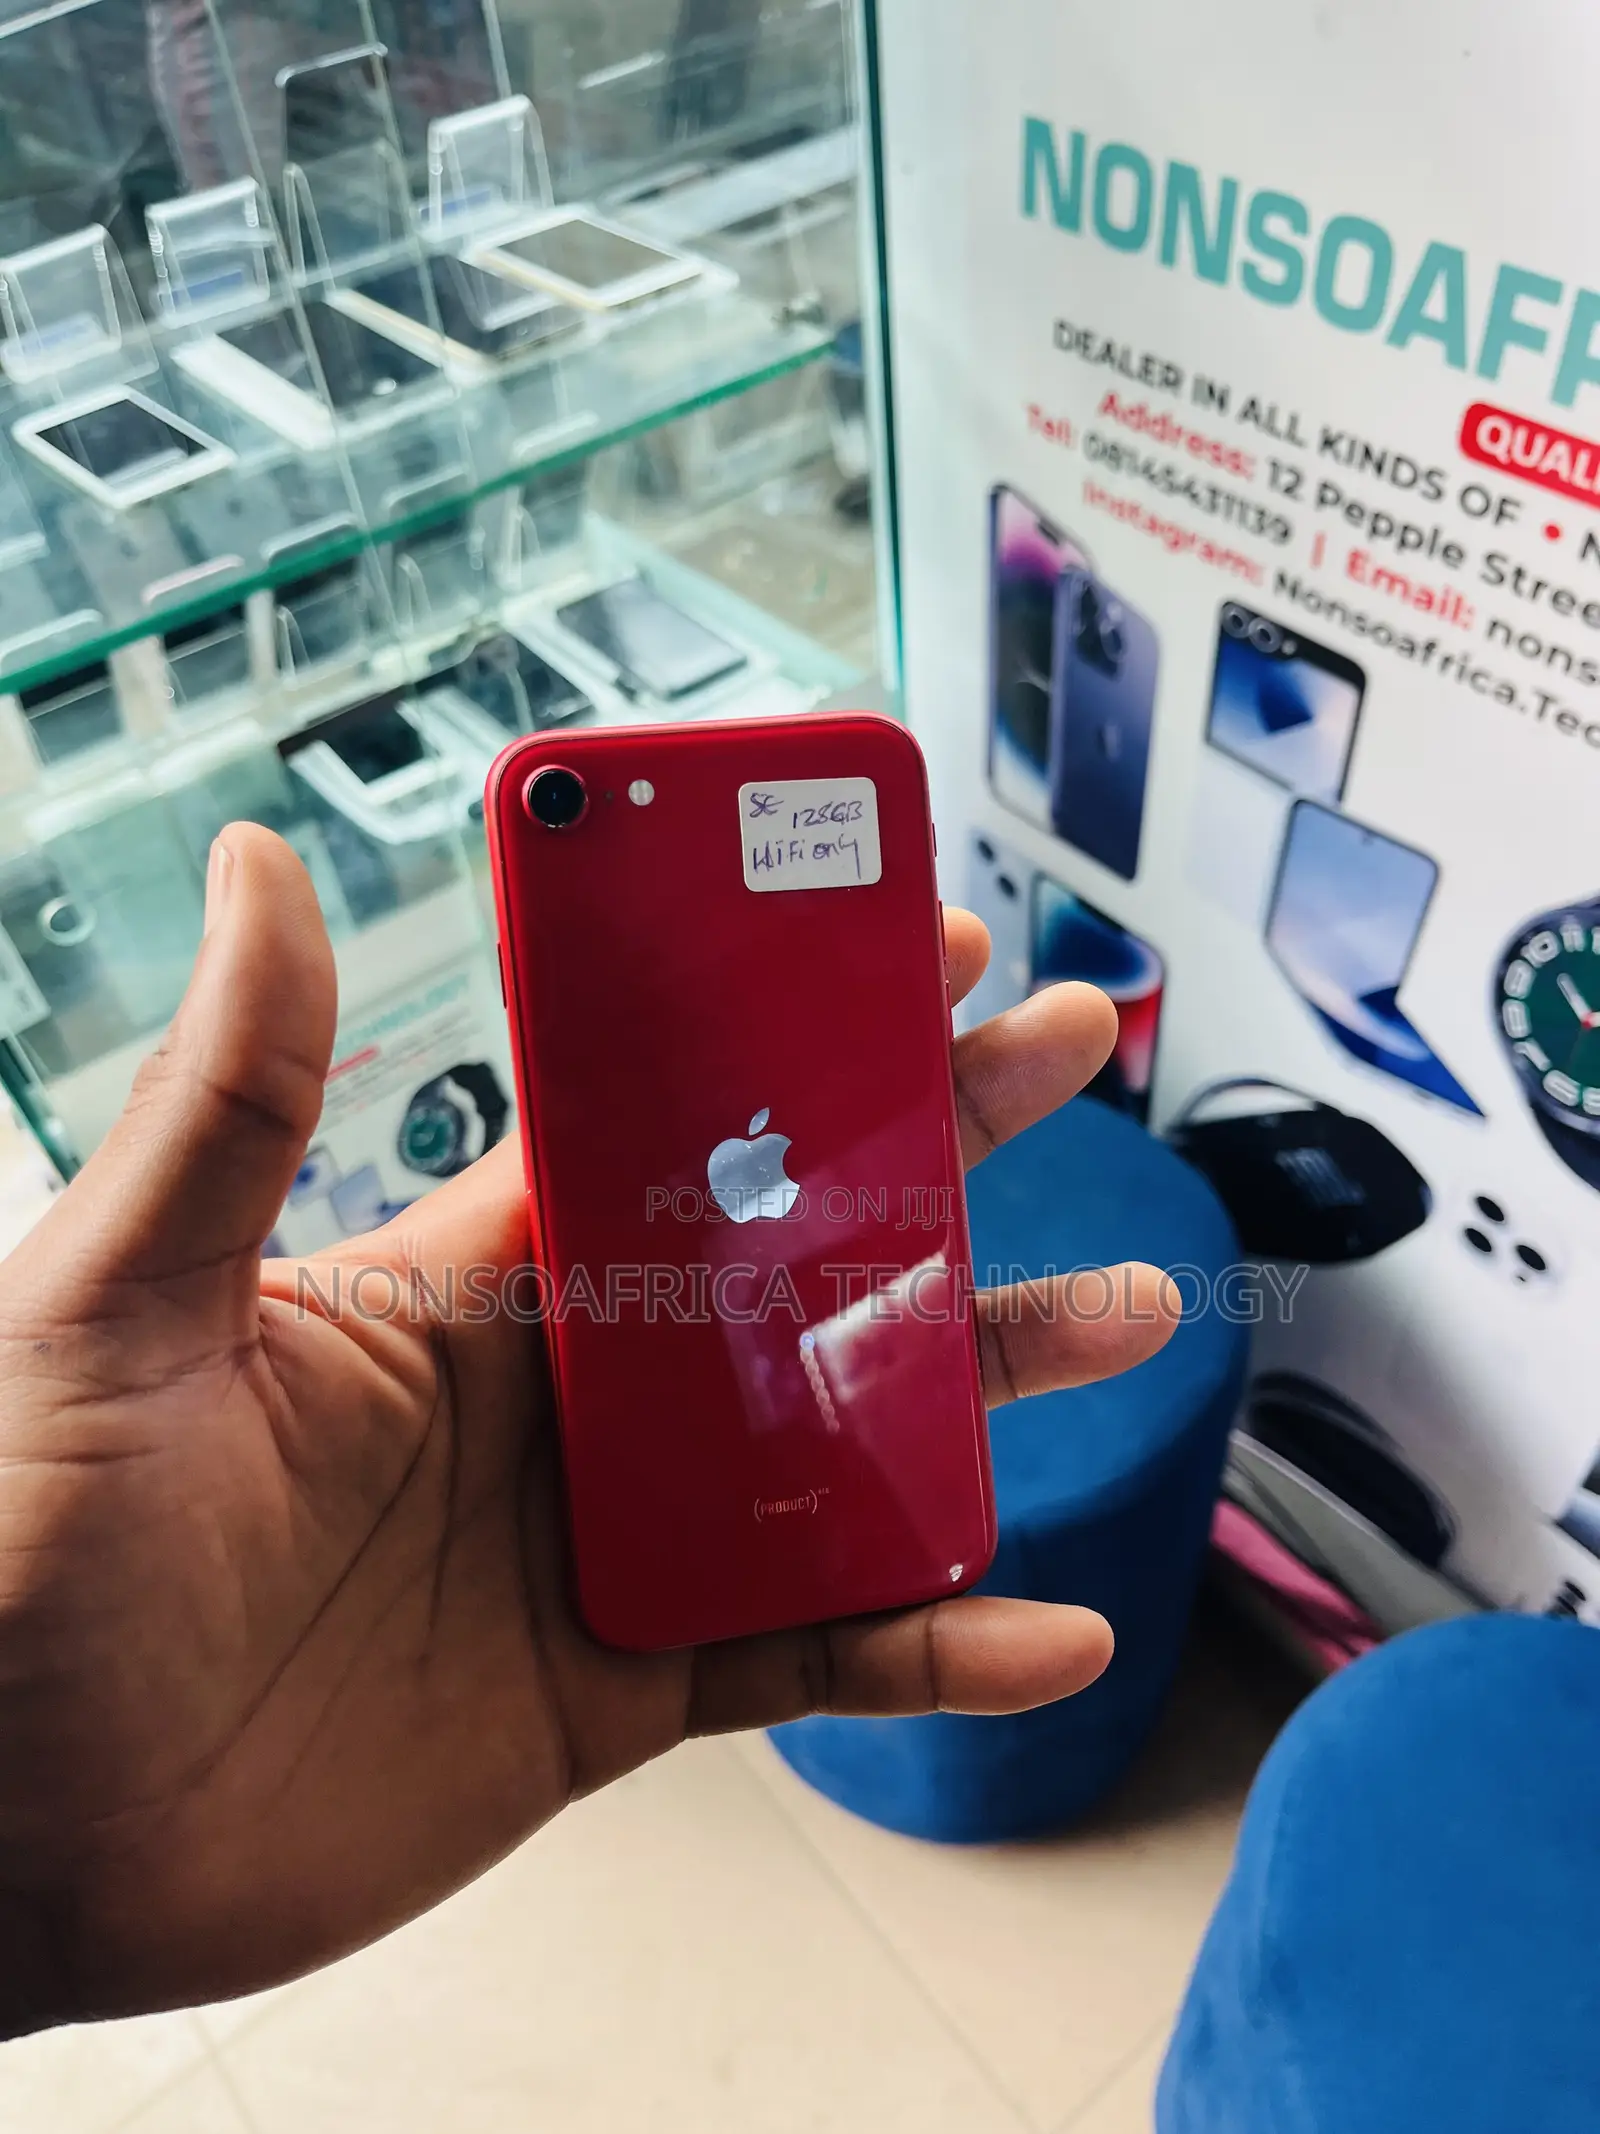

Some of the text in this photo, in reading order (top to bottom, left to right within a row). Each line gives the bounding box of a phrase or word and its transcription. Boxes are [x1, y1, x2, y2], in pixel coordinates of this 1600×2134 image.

[1053, 318, 1522, 525] DEALER IN ALL KINDS OF
[1268, 456, 1304, 501] 12
[1314, 478, 1465, 570] Pepple
[1344, 547, 1477, 630] Email:
[793, 800, 863, 829] 128GB
